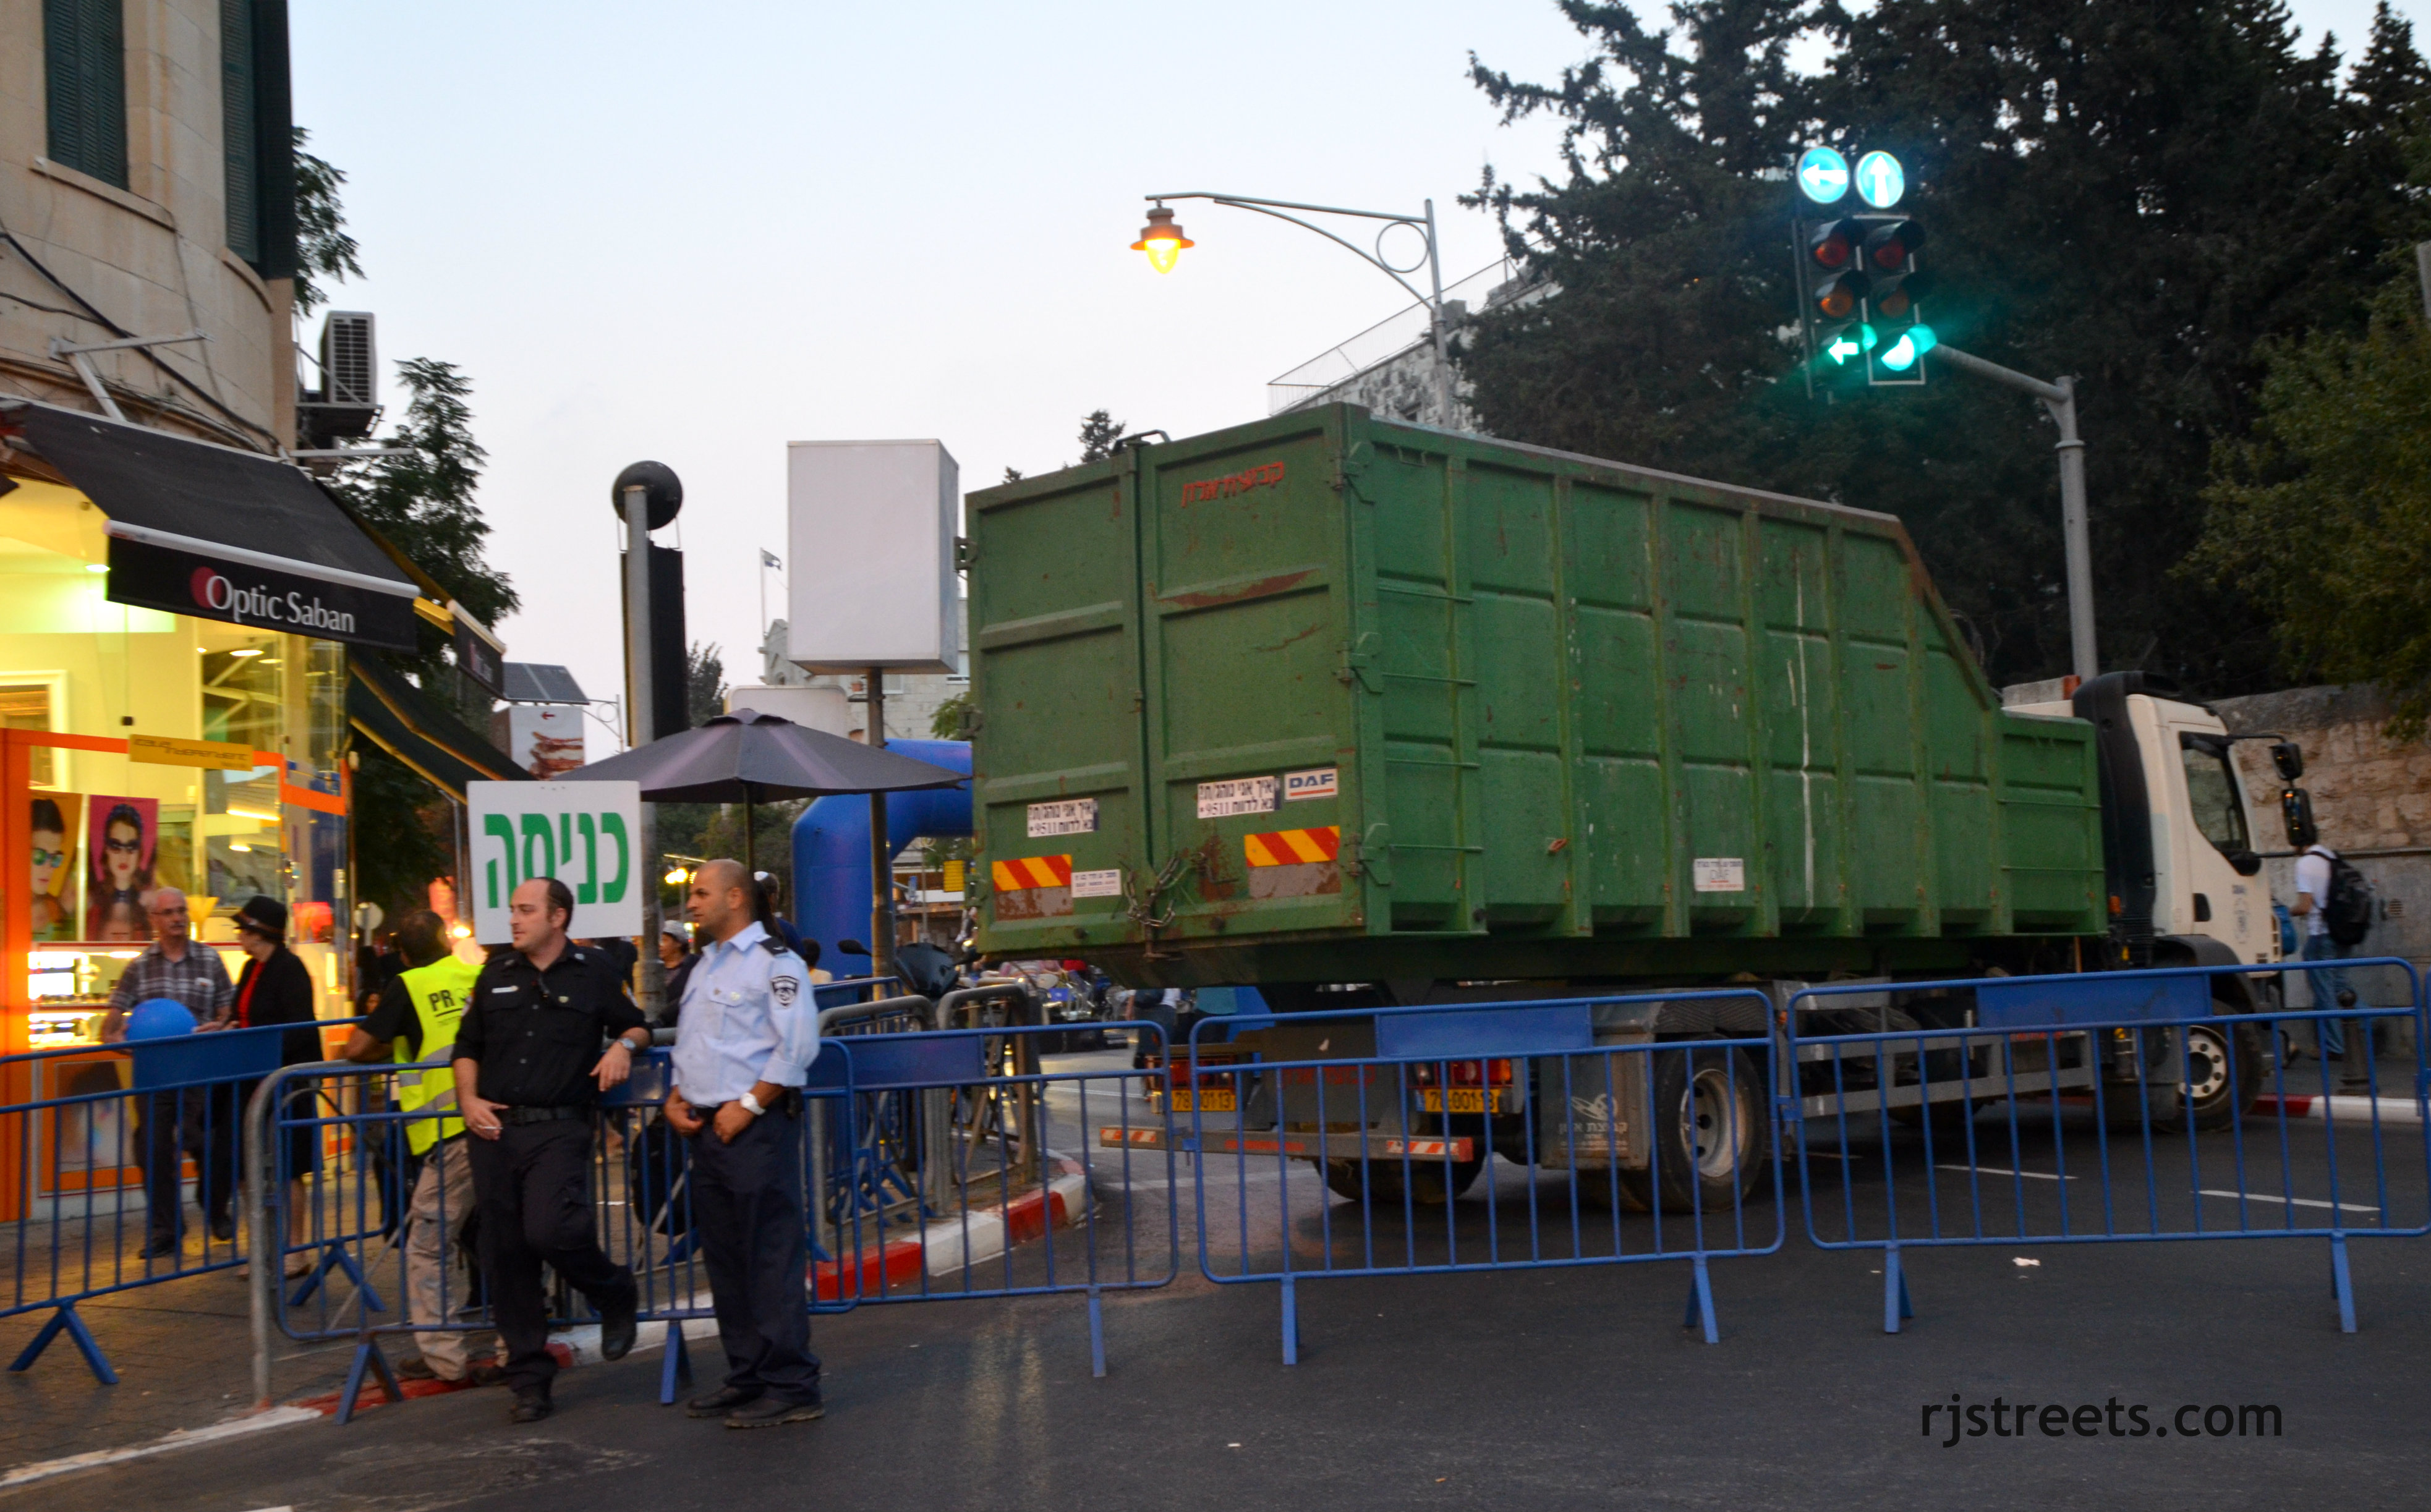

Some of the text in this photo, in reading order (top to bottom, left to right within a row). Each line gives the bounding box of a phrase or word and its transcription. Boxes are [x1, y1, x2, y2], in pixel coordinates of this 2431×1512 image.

[206, 575, 356, 634] Optic Saban
[1289, 773, 1334, 789] DAF
[483, 812, 629, 909] כניסה
